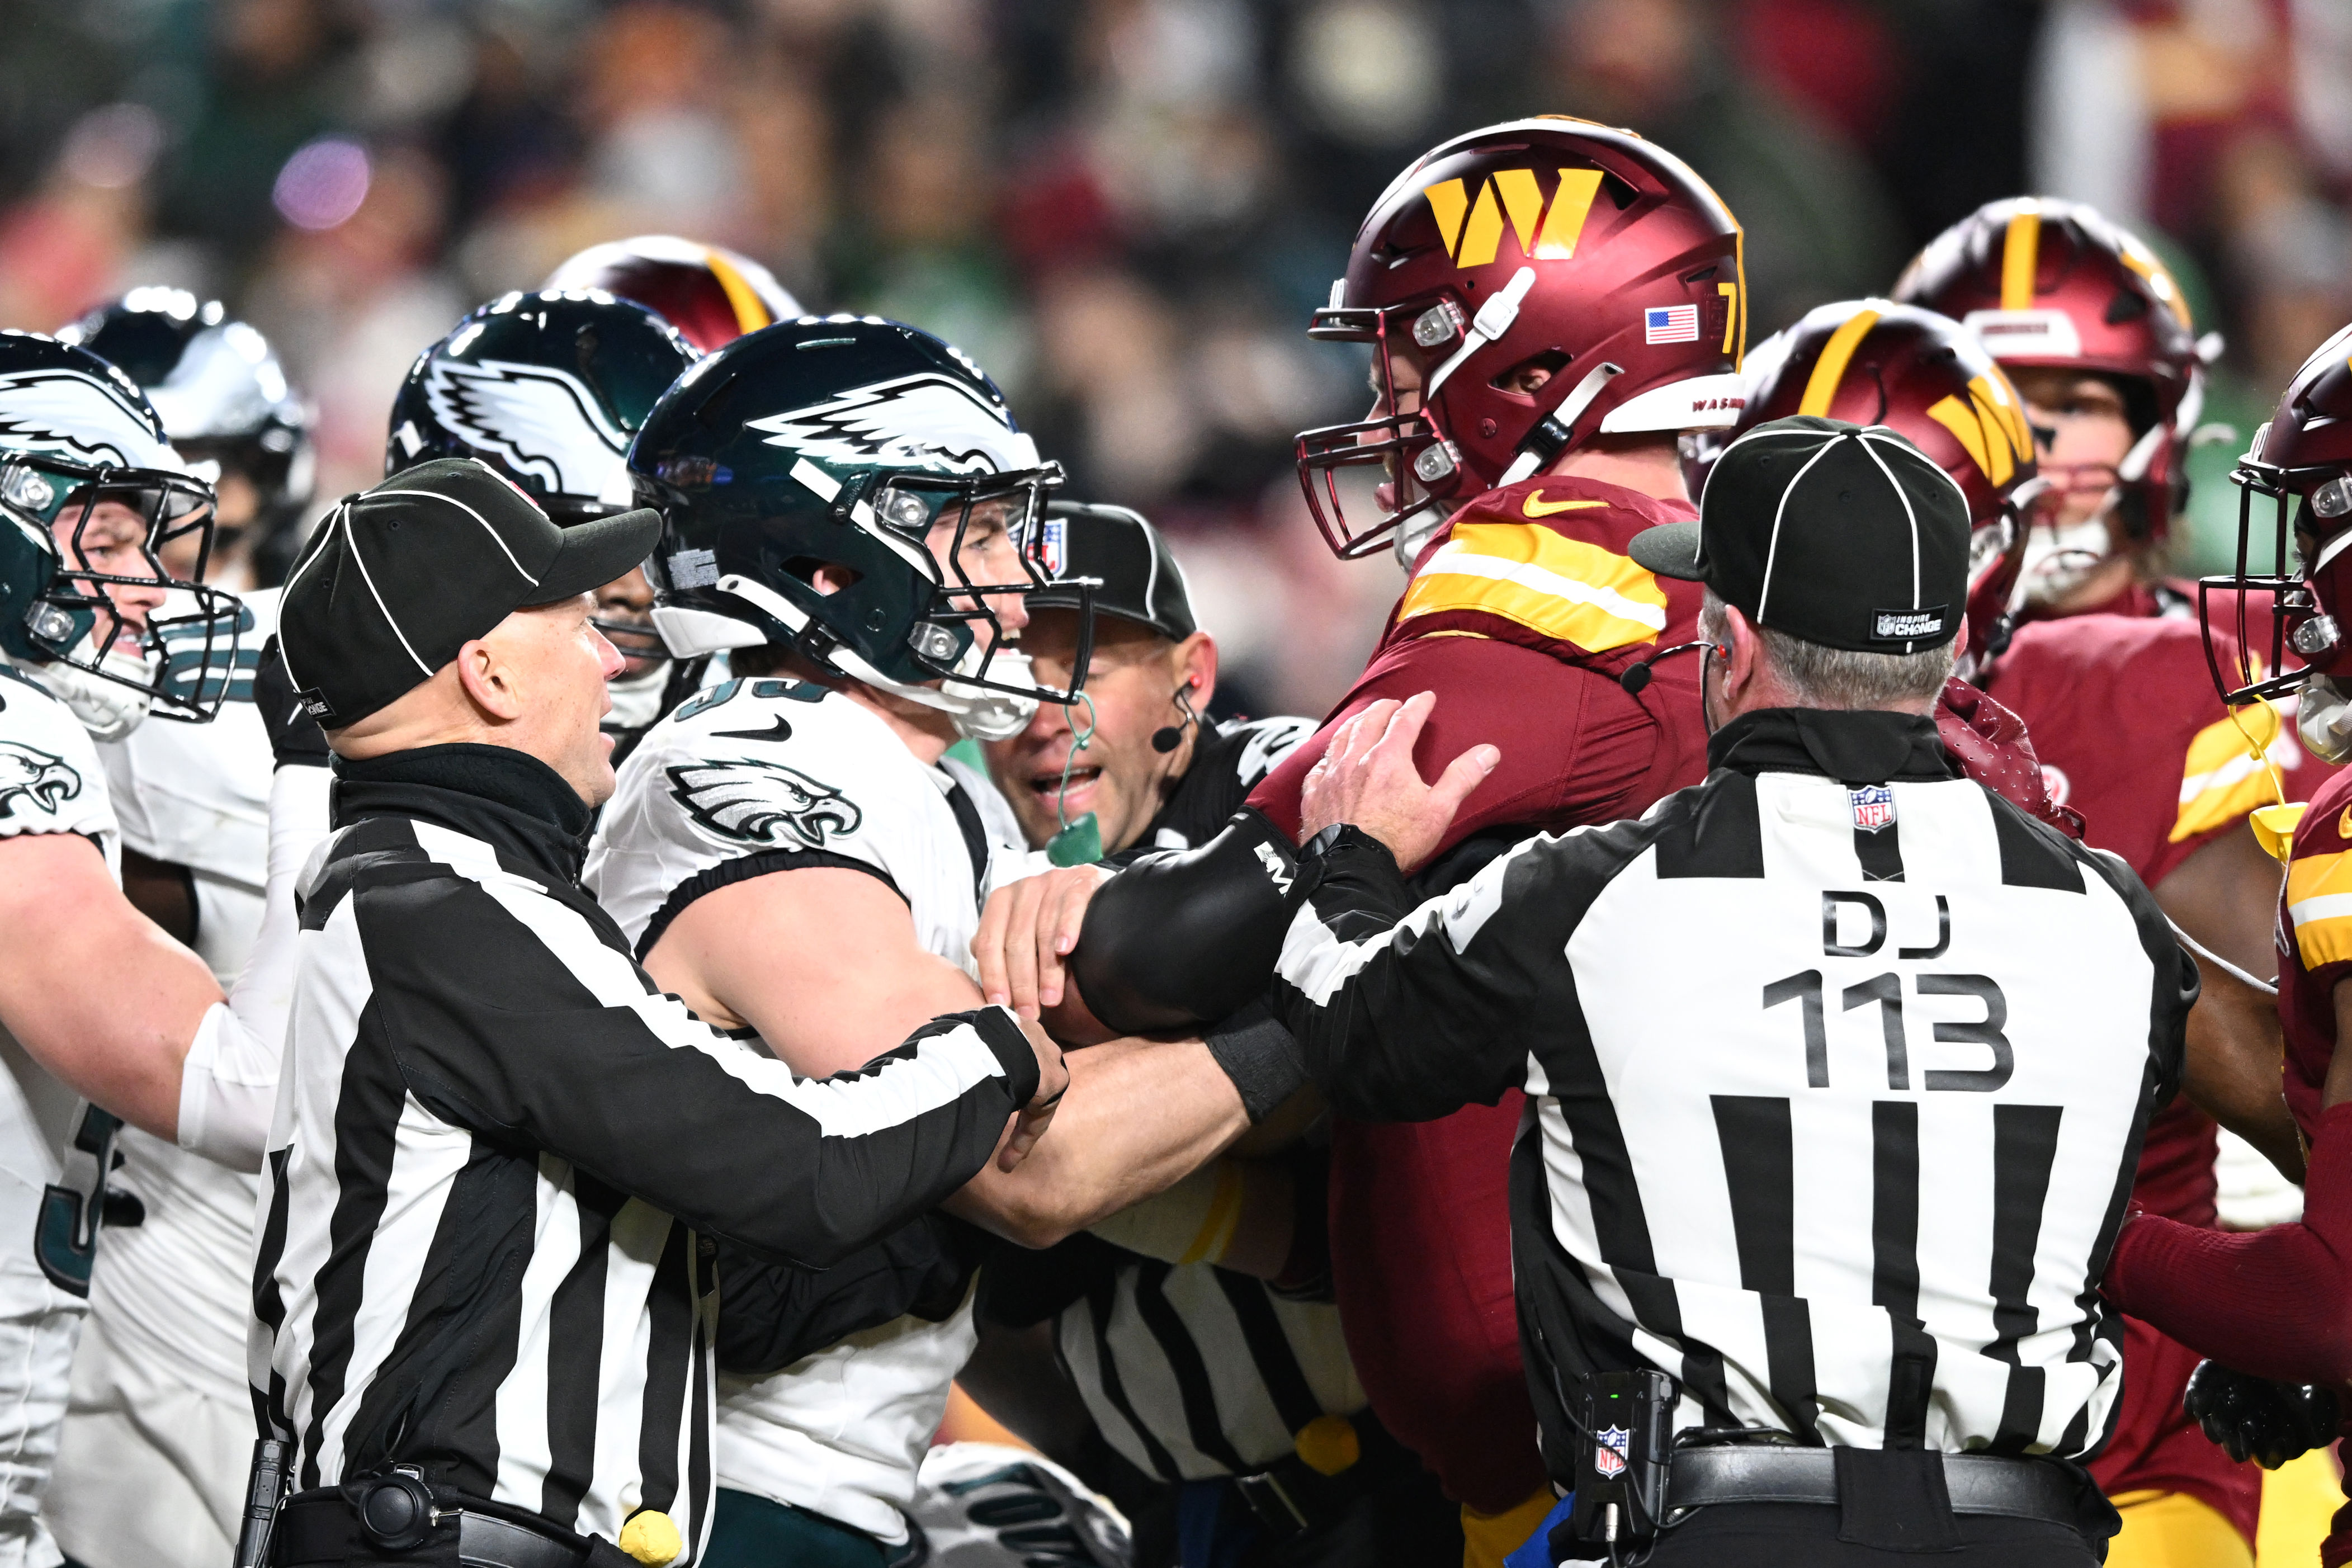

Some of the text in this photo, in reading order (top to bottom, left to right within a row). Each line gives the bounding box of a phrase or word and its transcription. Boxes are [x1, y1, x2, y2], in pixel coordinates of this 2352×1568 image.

[1424, 168, 1604, 268] W
[1718, 282, 1737, 353] 7
[1895, 619, 1942, 635] CHANGE
[1896, 613, 1930, 624] INSPIRE
[1857, 805, 1891, 826] NFL
[1822, 890, 1950, 960] DJ
[1762, 969, 2014, 1093] 113
